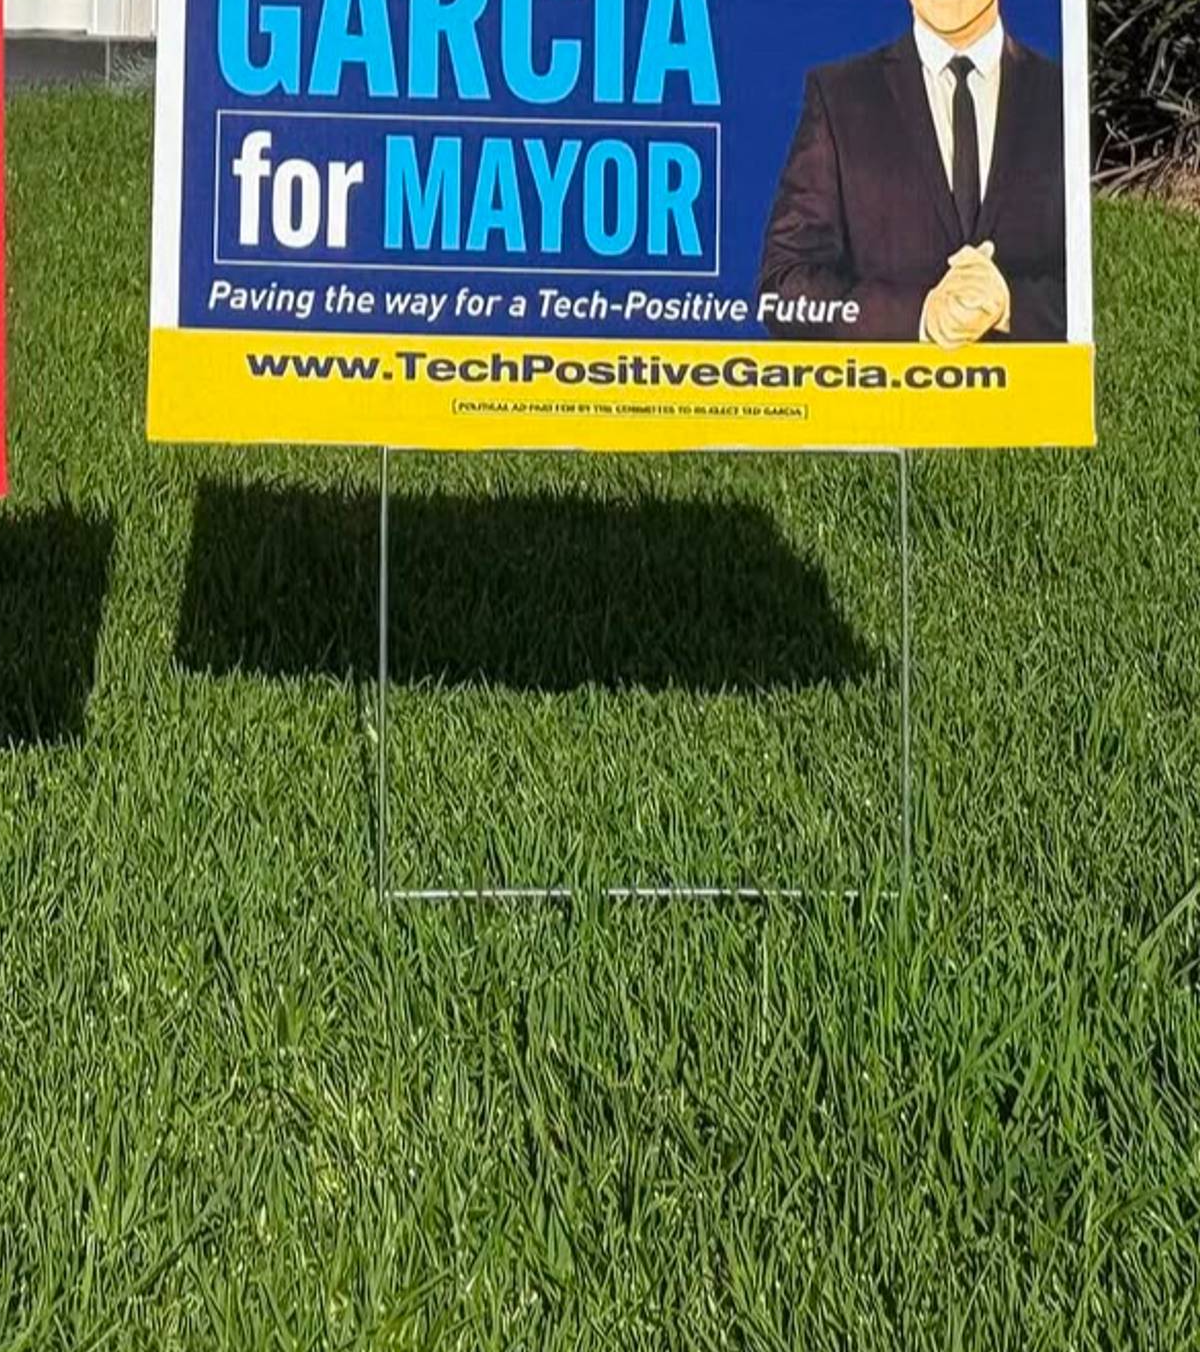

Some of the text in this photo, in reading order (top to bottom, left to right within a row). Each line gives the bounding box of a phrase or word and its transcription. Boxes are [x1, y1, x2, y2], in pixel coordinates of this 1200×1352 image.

[232, 130, 703, 257] for MAYOR
[208, 279, 860, 324] Paving the way for a Tech-Positive Future
[246, 351, 1008, 389] www.TechPositiveGarcia.com
